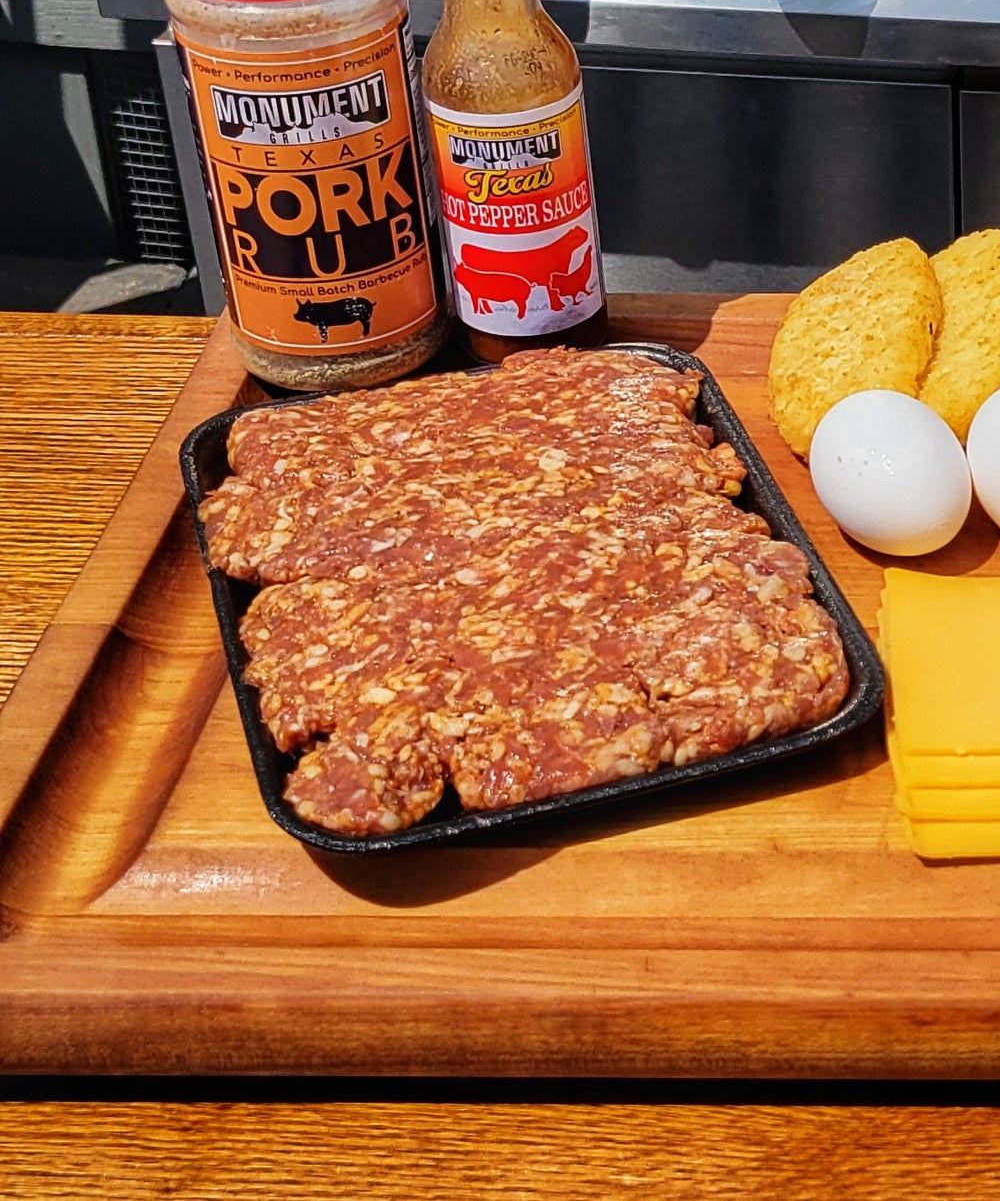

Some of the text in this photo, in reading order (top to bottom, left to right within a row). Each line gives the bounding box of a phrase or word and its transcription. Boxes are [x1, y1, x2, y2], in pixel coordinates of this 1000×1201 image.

[192, 43, 396, 83] Power Performance Precision
[213, 75, 383, 128] MONUMENT
[457, 126, 530, 137] Performance
[539, 108, 577, 130] Precision
[231, 133, 385, 167] TEXAS
[269, 126, 341, 144] GRILLS
[449, 130, 559, 160] MONUMENT
[215, 142, 414, 236] PORK
[441, 180, 588, 228] HOT PEPPER SAUCE
[464, 162, 554, 204] Texas
[232, 212, 417, 278] RUB
[235, 252, 428, 297] Premium Small Batch Barbecue Rub
